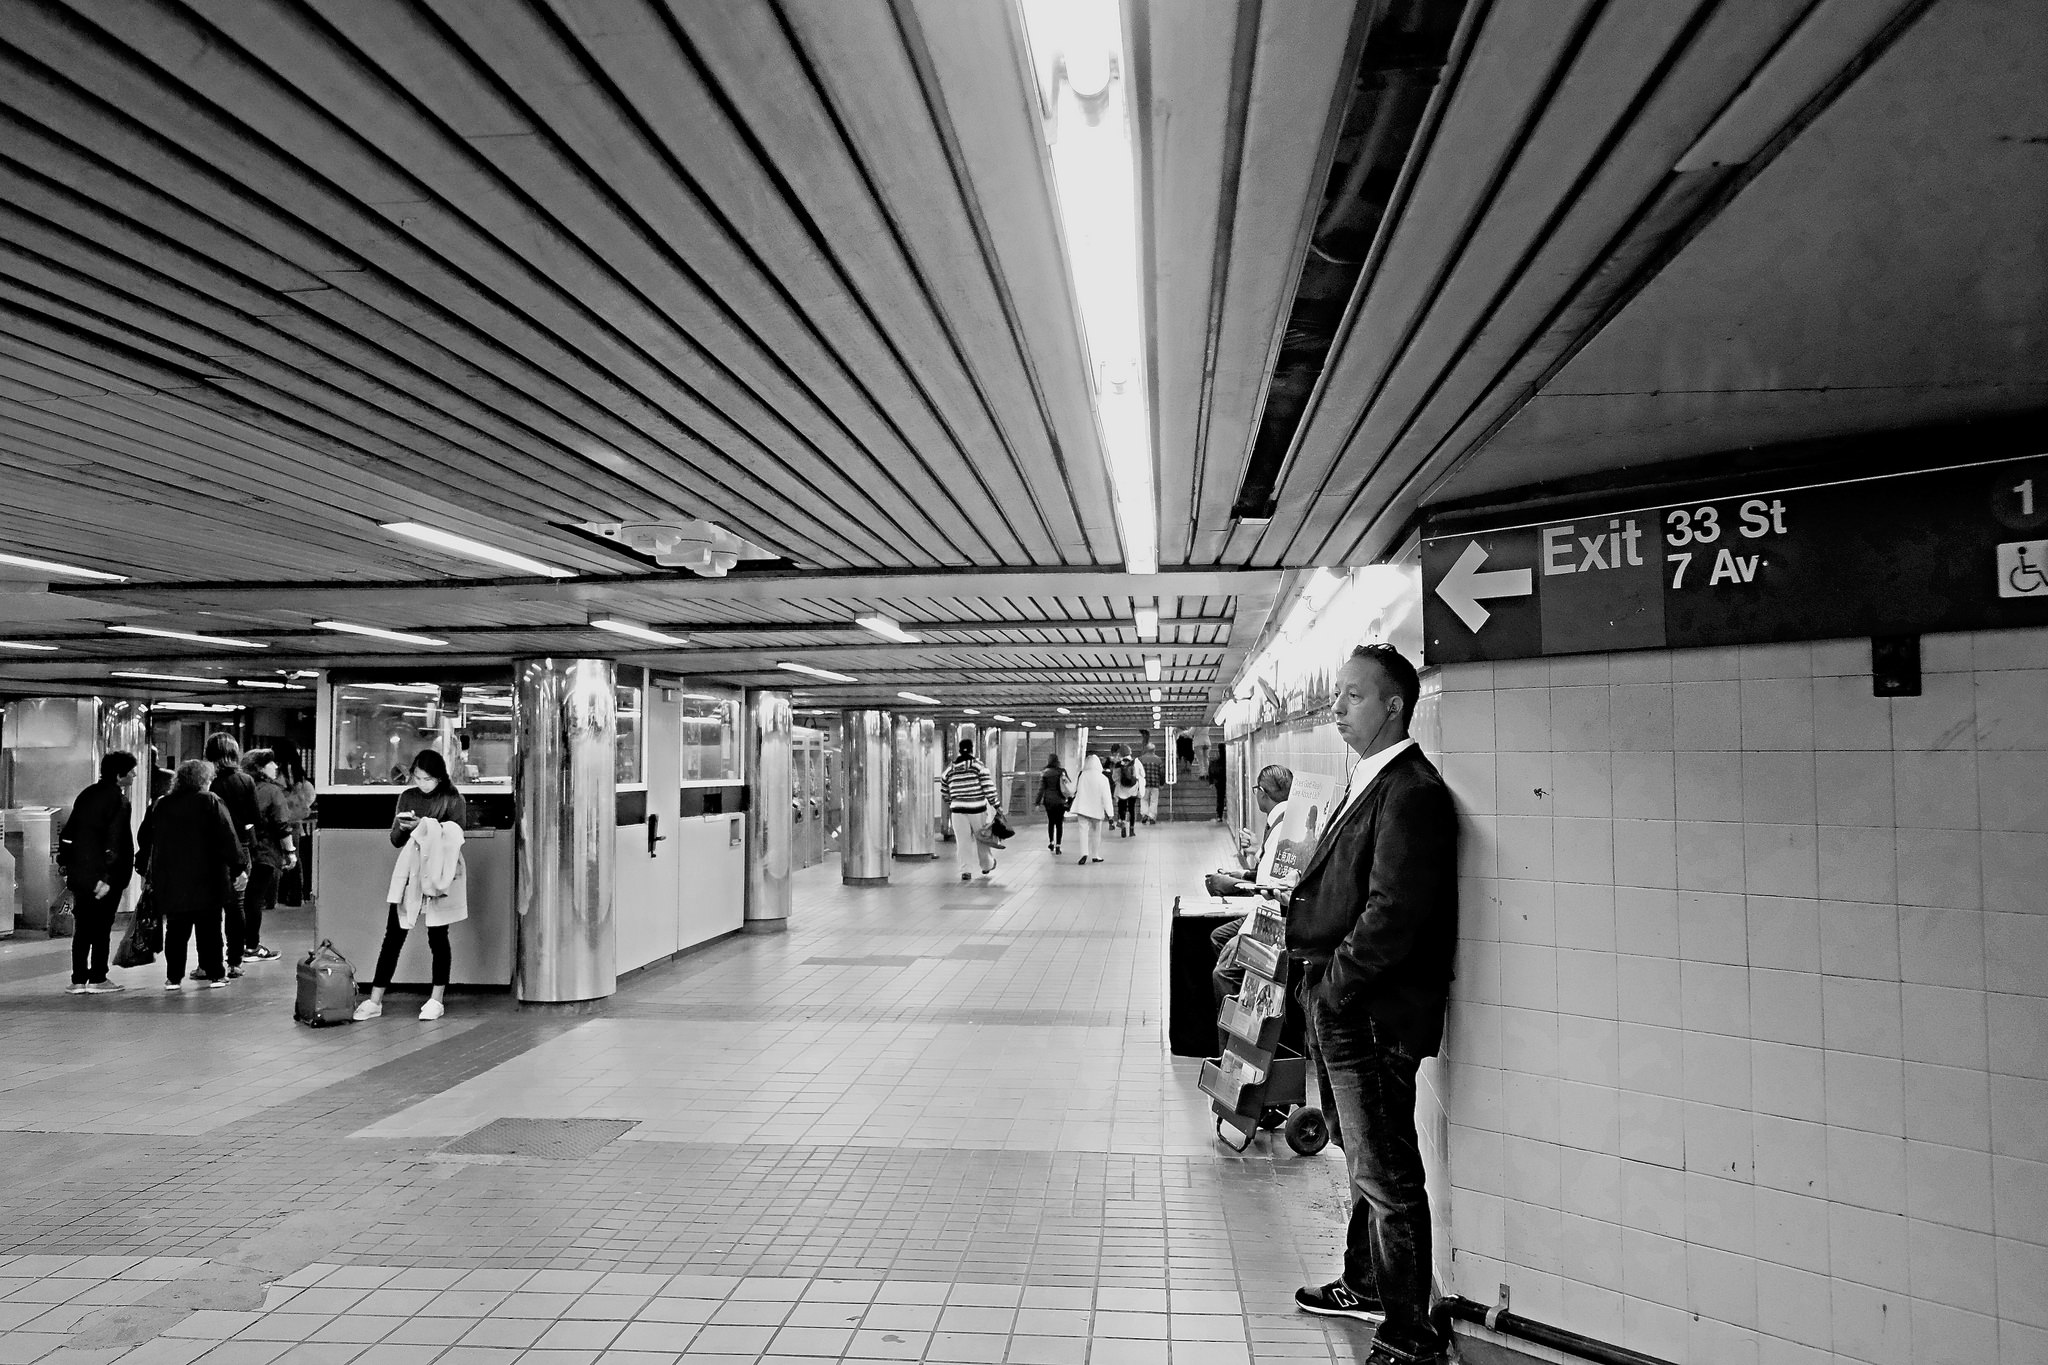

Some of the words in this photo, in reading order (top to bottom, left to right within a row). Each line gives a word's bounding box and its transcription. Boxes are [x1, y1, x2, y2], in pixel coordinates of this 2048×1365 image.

[2013, 479, 2034, 515] 1
[1666, 506, 1721, 546] 33
[1739, 500, 1788, 538] St
[1543, 519, 1643, 576] Exit
[1667, 552, 1693, 589] 7
[1709, 549, 1760, 586] Av
[1332, 1287, 1358, 1307] N
